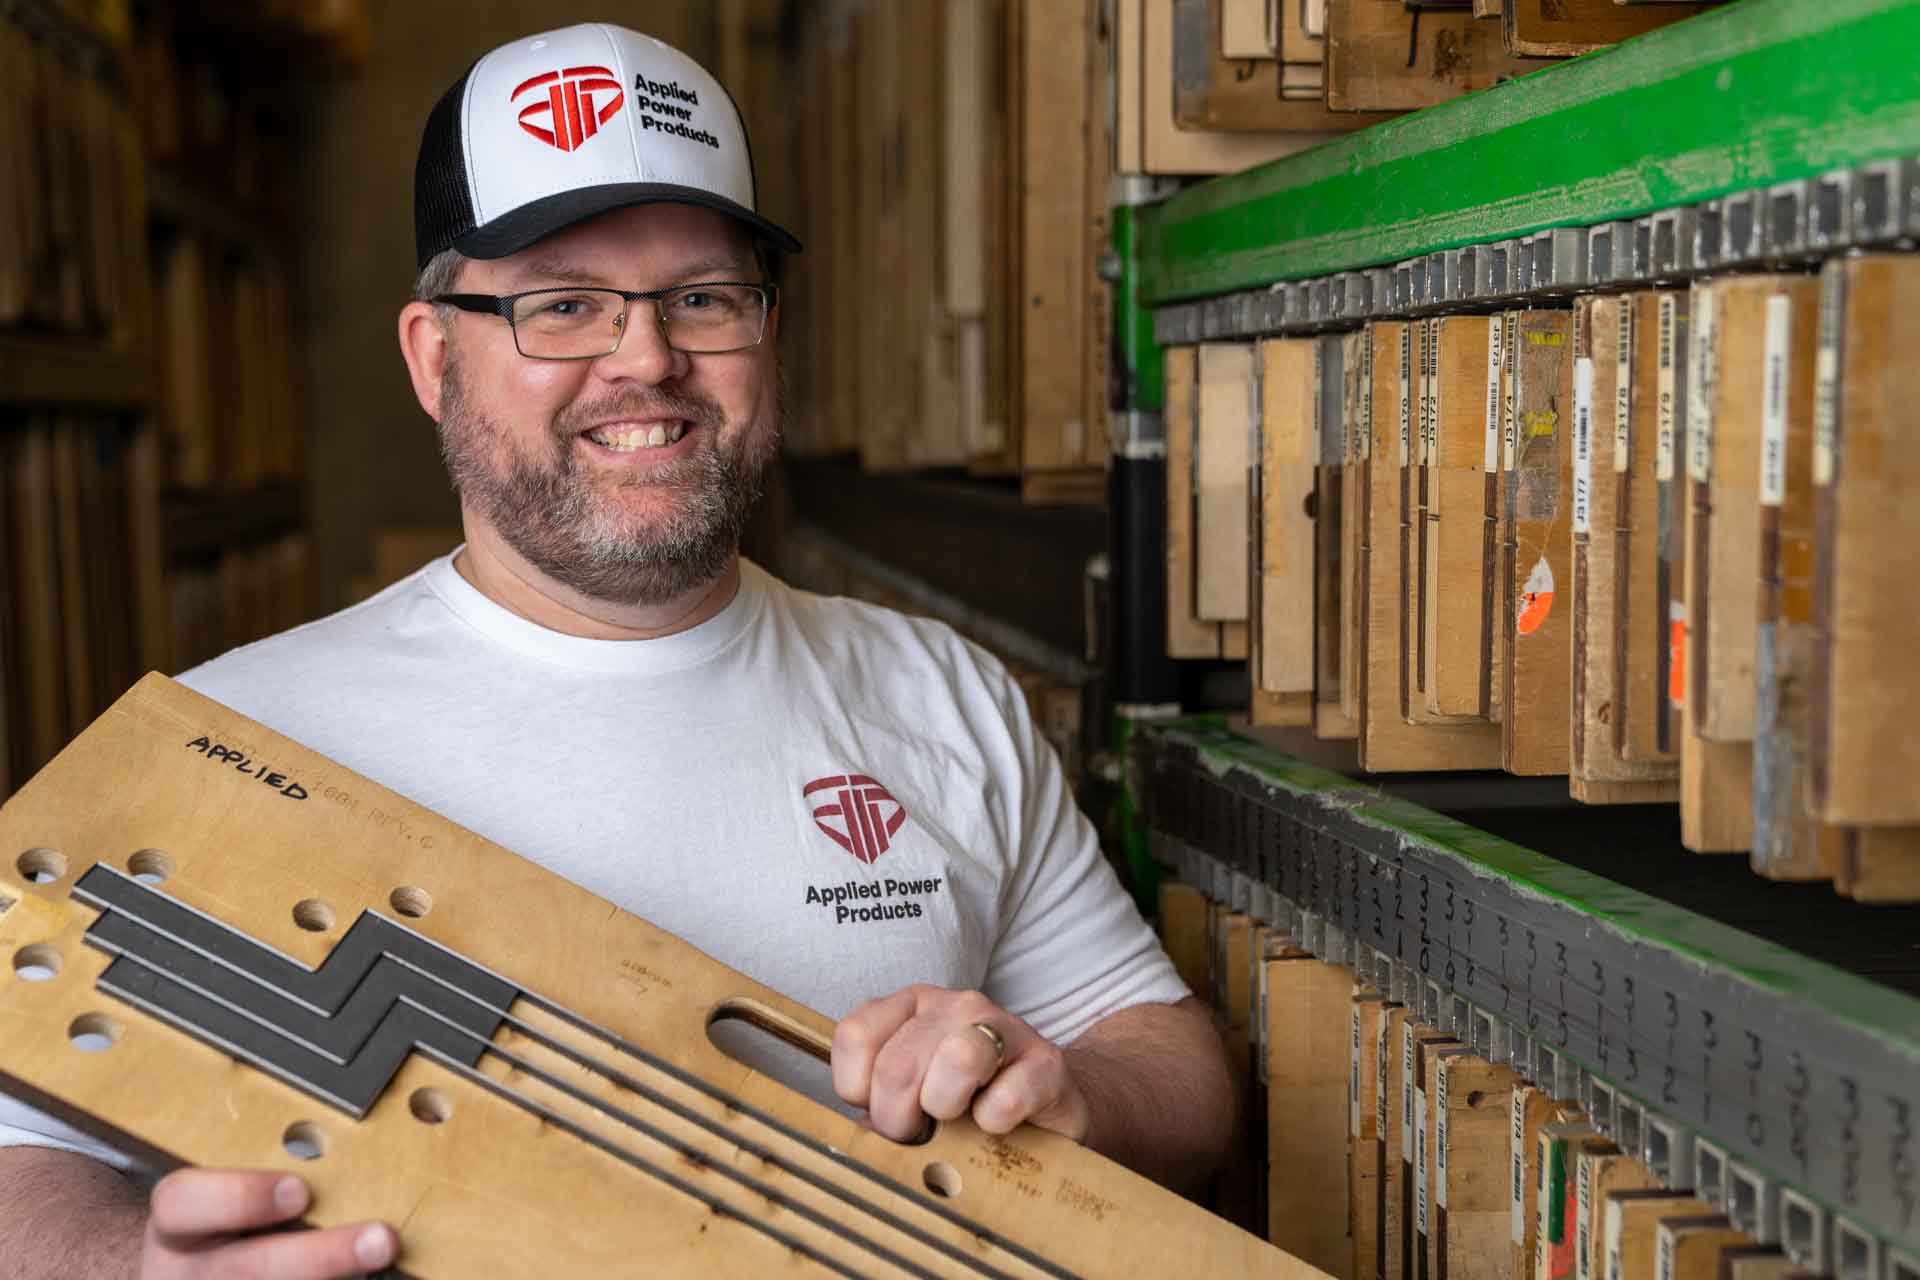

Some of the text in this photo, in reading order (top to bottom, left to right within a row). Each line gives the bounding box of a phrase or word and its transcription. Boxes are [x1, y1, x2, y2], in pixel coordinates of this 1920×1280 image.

[635, 73, 699, 106] Applied
[637, 94, 692, 122] Power
[641, 114, 719, 149] Products
[1429, 396, 1437, 447] J3172
[1505, 395, 1513, 448] J3174
[1577, 478, 1585, 523] J3177
[186, 736, 308, 800] APPLIED
[805, 877, 942, 907] Applied Power
[835, 901, 922, 924] Products
[1419, 875, 1429, 973] 320
[1445, 880, 1455, 992] 319
[1497, 915, 1509, 1010] 317
[1526, 929, 1538, 1030] 316
[1555, 941, 1568, 1047] 315
[1592, 960, 1609, 1074] 314
[1623, 977, 1638, 1080] 313
[1664, 991, 1678, 1104] 312
[1701, 1009, 1717, 1123] 311
[1744, 1029, 1763, 1148] 310
